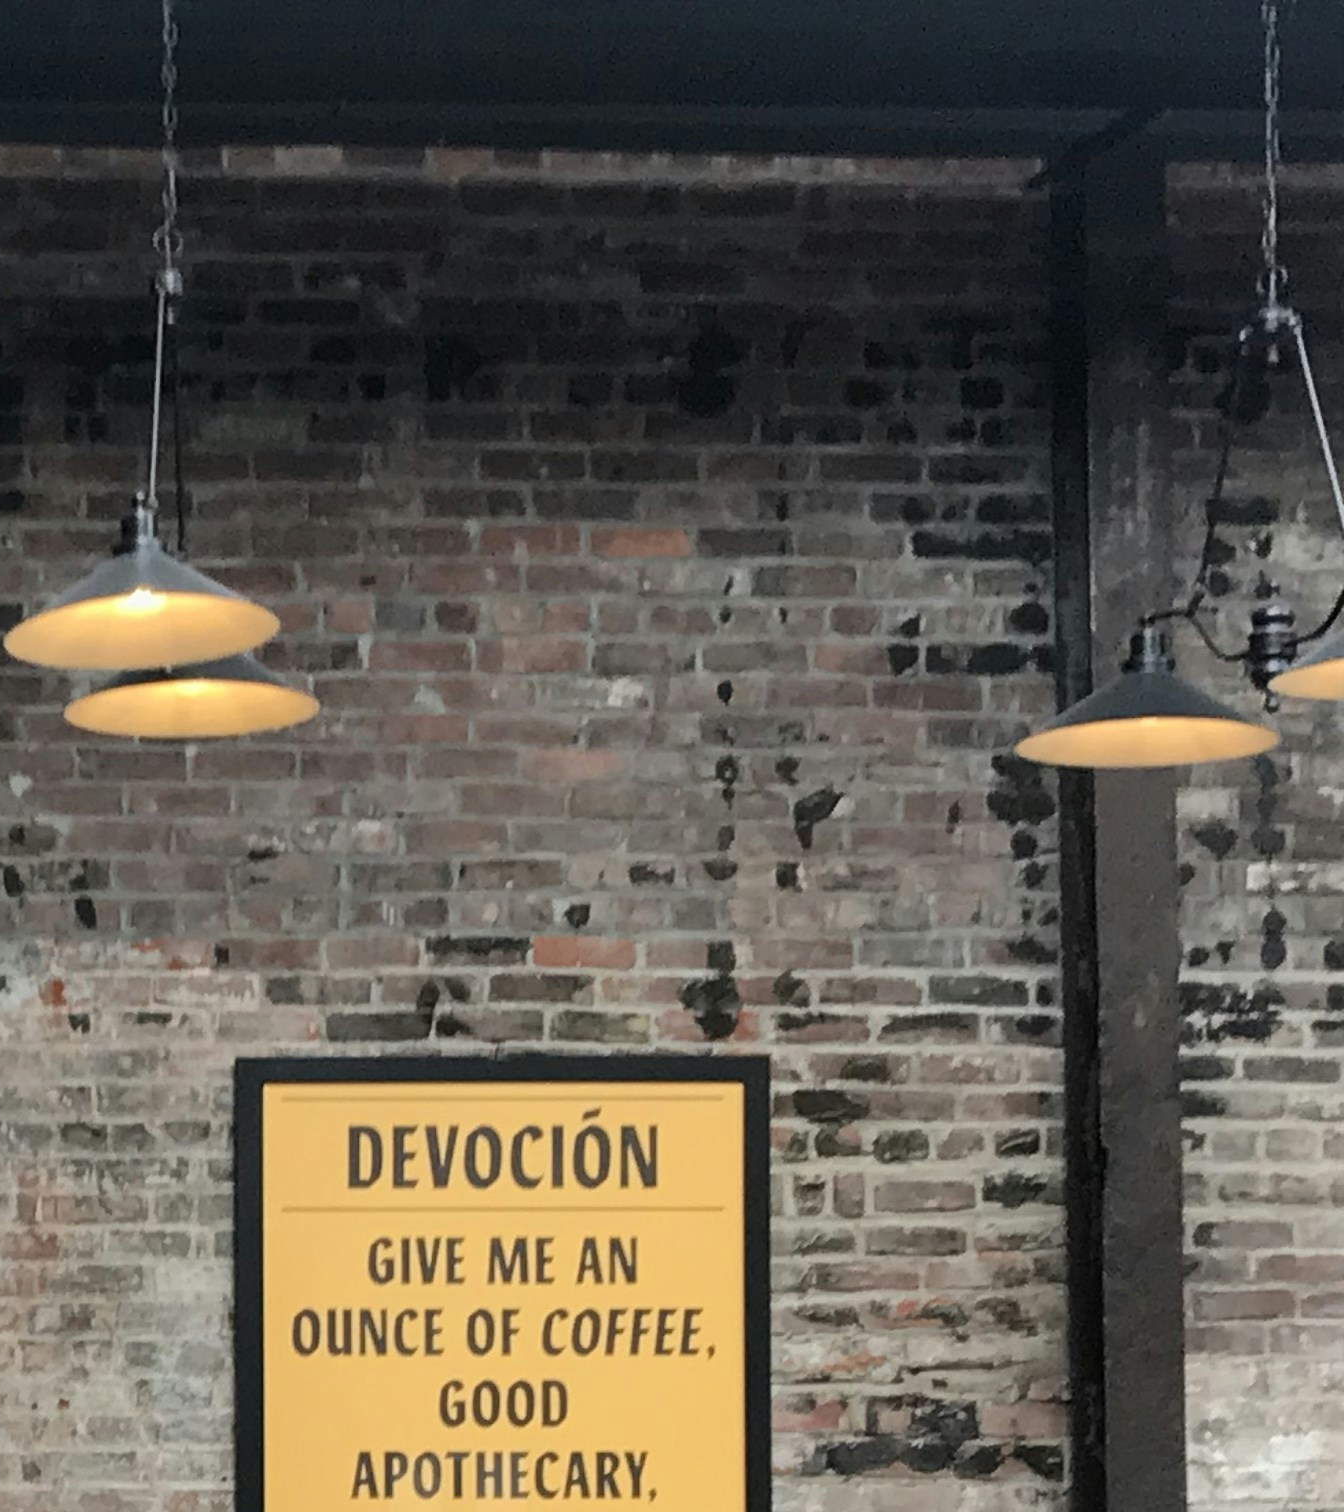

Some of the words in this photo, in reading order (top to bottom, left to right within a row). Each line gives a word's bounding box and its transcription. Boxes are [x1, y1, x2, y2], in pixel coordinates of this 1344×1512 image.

[346, 1108, 659, 1190] DEVOCIÓN
[366, 1237, 467, 1286] GIVE
[486, 1236, 556, 1285] ME
[575, 1236, 639, 1285] AN
[290, 1308, 445, 1357] OUNCE
[465, 1308, 521, 1357] OF
[540, 1308, 716, 1359] COFFEE,
[438, 1379, 569, 1428] GOOD
[350, 1451, 658, 1502] APOTHECARY,
